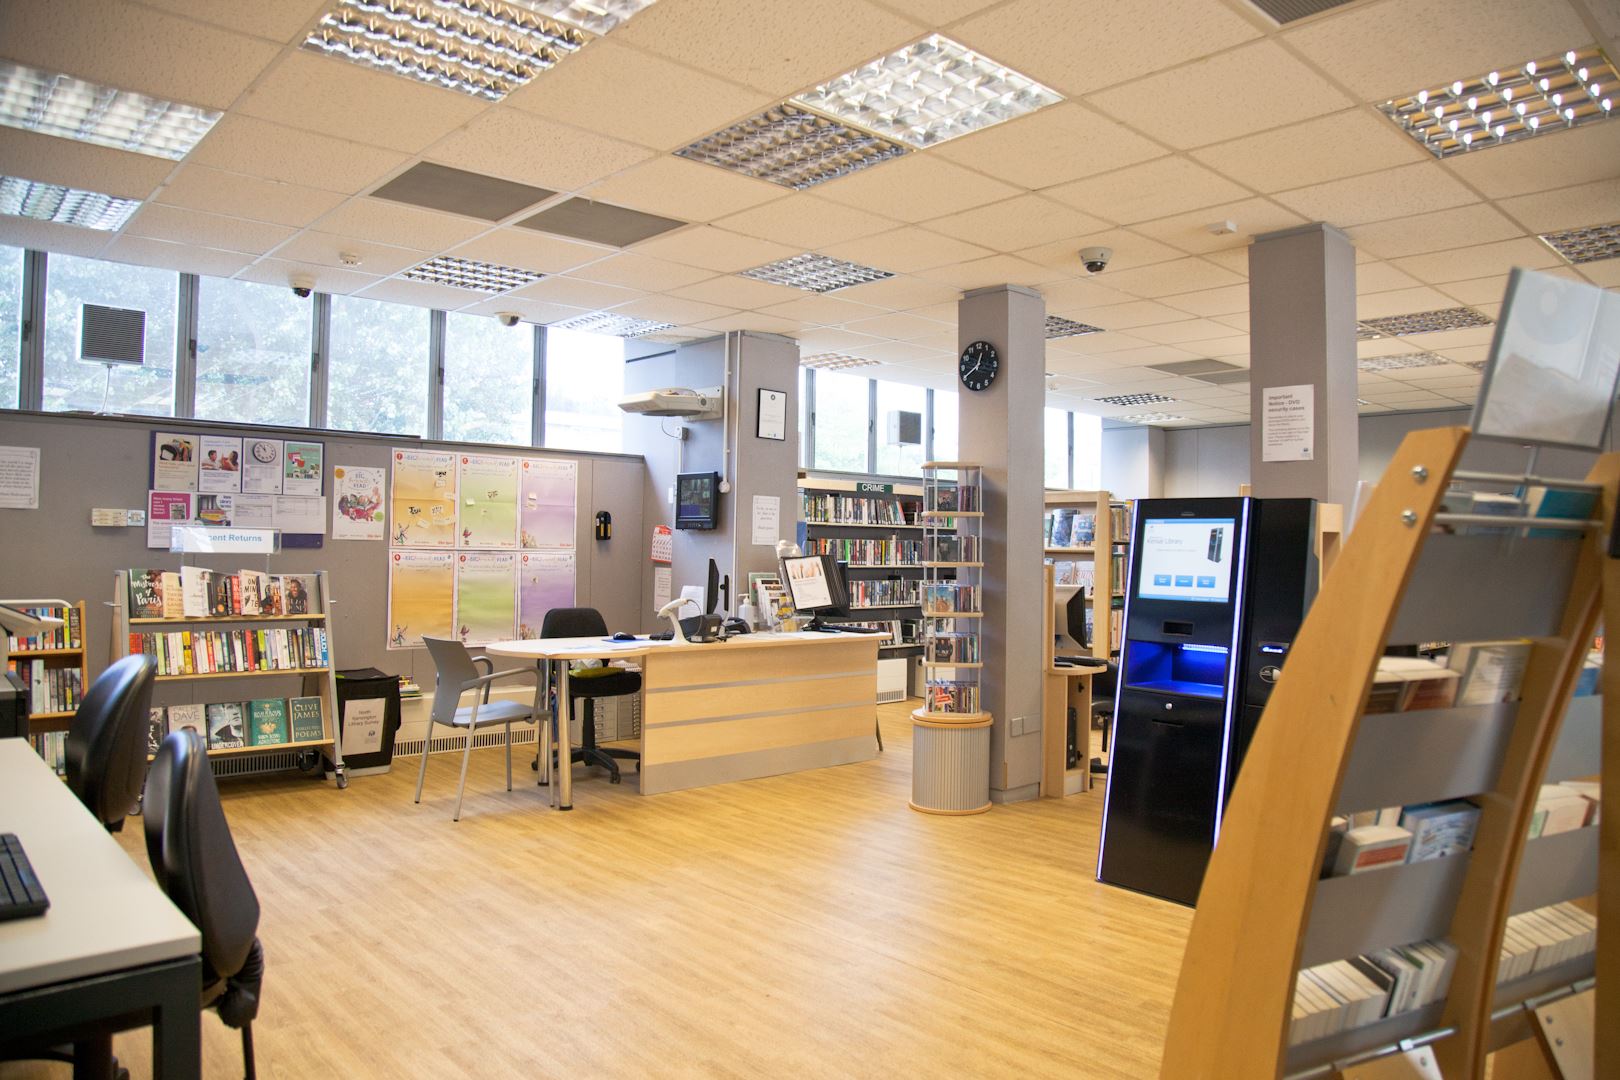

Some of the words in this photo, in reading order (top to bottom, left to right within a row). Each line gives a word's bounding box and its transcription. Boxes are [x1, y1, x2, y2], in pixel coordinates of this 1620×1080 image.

[862, 484, 884, 492] CRIME
[132, 580, 162, 588] Mistress
[136, 592, 162, 607] Paris
[173, 711, 200, 721] DAVE
[295, 711, 320, 720] JAMES
